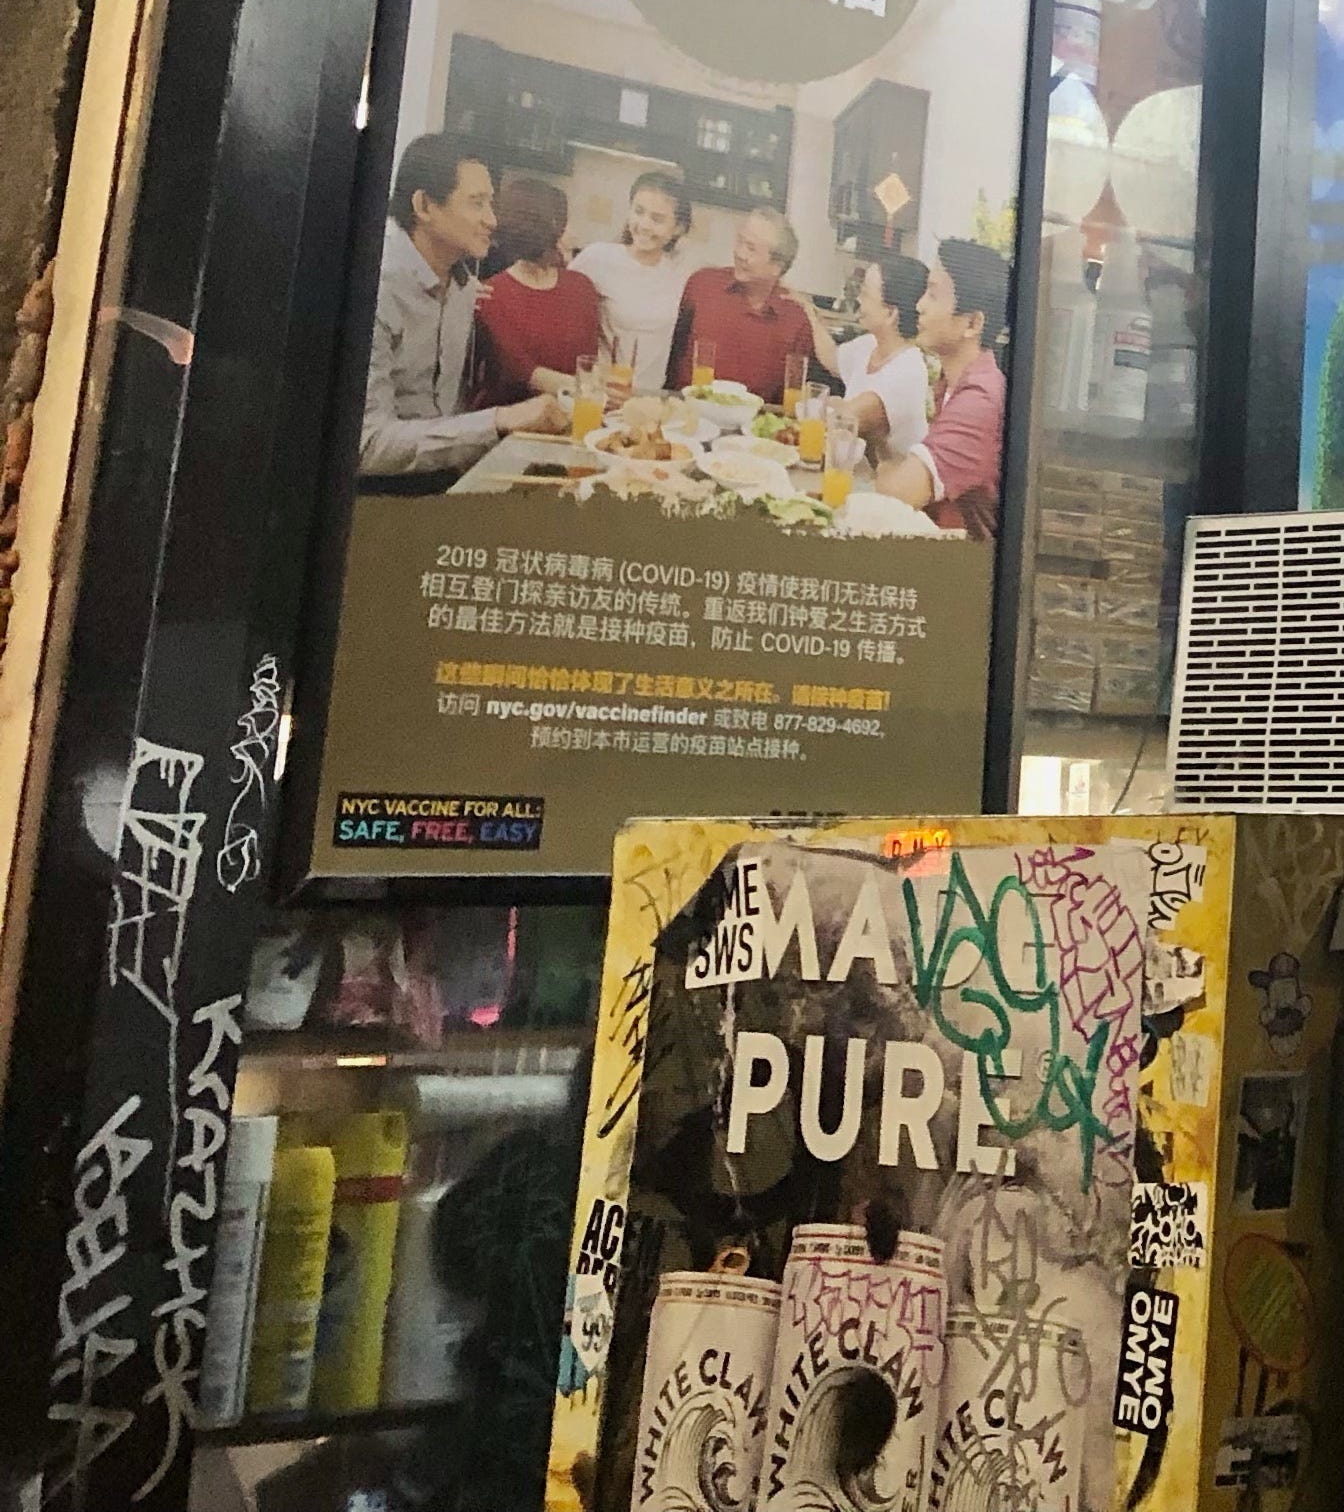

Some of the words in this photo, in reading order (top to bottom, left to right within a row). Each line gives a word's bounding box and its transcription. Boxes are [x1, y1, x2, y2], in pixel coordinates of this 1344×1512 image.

[436, 544, 489, 569] 2019
[495, 546, 615, 583] 冠状病毒病
[618, 560, 731, 594] (COVID-19)
[737, 571, 918, 612] 疫情使我们无法保持
[760, 632, 851, 658] COVID-19
[857, 638, 905, 665] 传播。
[437, 690, 481, 717] 访问
[486, 696, 708, 726] nyc.gov/vaccinefinder
[713, 707, 768, 732] 或致电
[338, 819, 404, 844] SAFE,
[410, 819, 475, 845] FREE,
[478, 820, 538, 843] EASY
[341, 797, 381, 816] NYC
[383, 798, 460, 817] VACCINE
[463, 800, 499, 818] FOR
[501, 801, 542, 819] ALL:
[727, 1031, 1024, 1178] PURE
[639, 1360, 694, 1505] WHITE
[699, 1347, 770, 1438] CLAW
[767, 1331, 830, 1501] WHITE
[837, 1317, 925, 1422] CLAW
